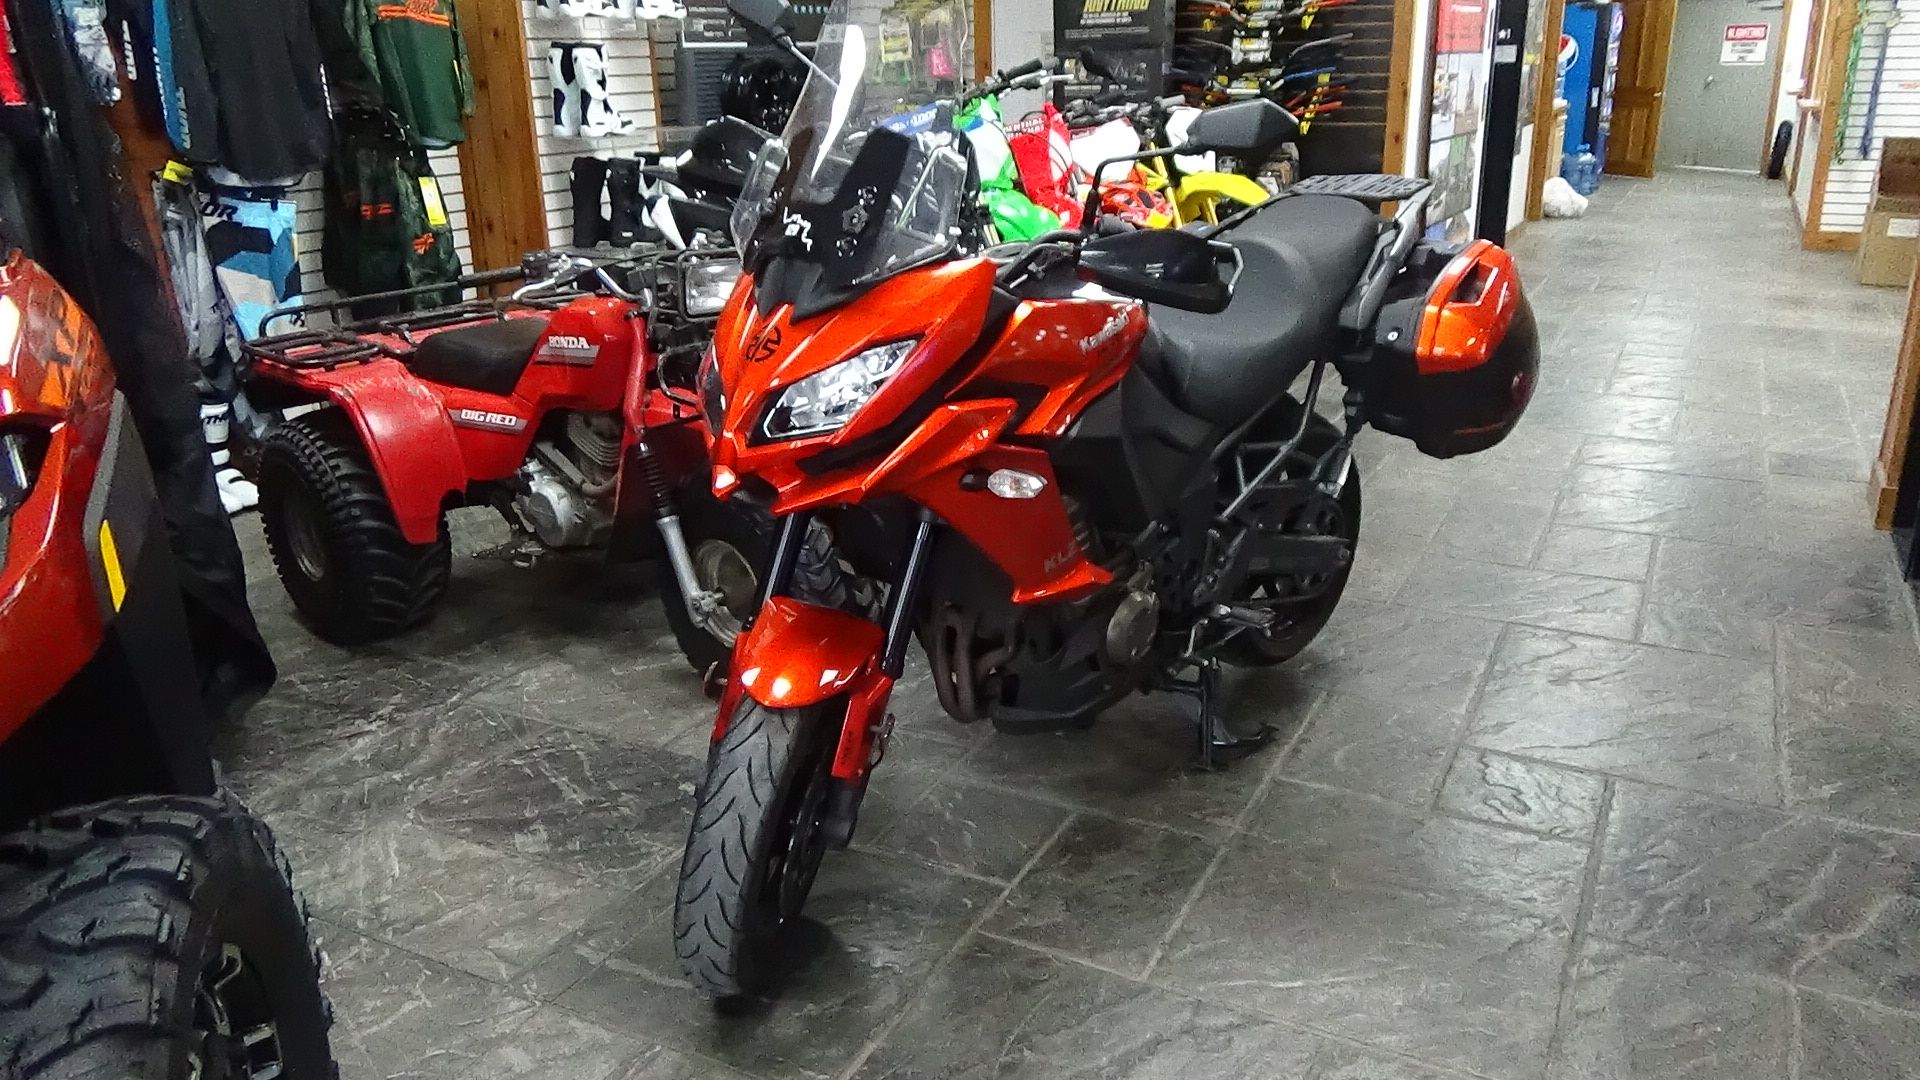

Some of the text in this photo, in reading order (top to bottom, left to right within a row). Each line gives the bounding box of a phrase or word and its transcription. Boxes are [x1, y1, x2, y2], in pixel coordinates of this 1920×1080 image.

[548, 335, 590, 349] HONDA
[460, 408, 517, 427] BIG RED
